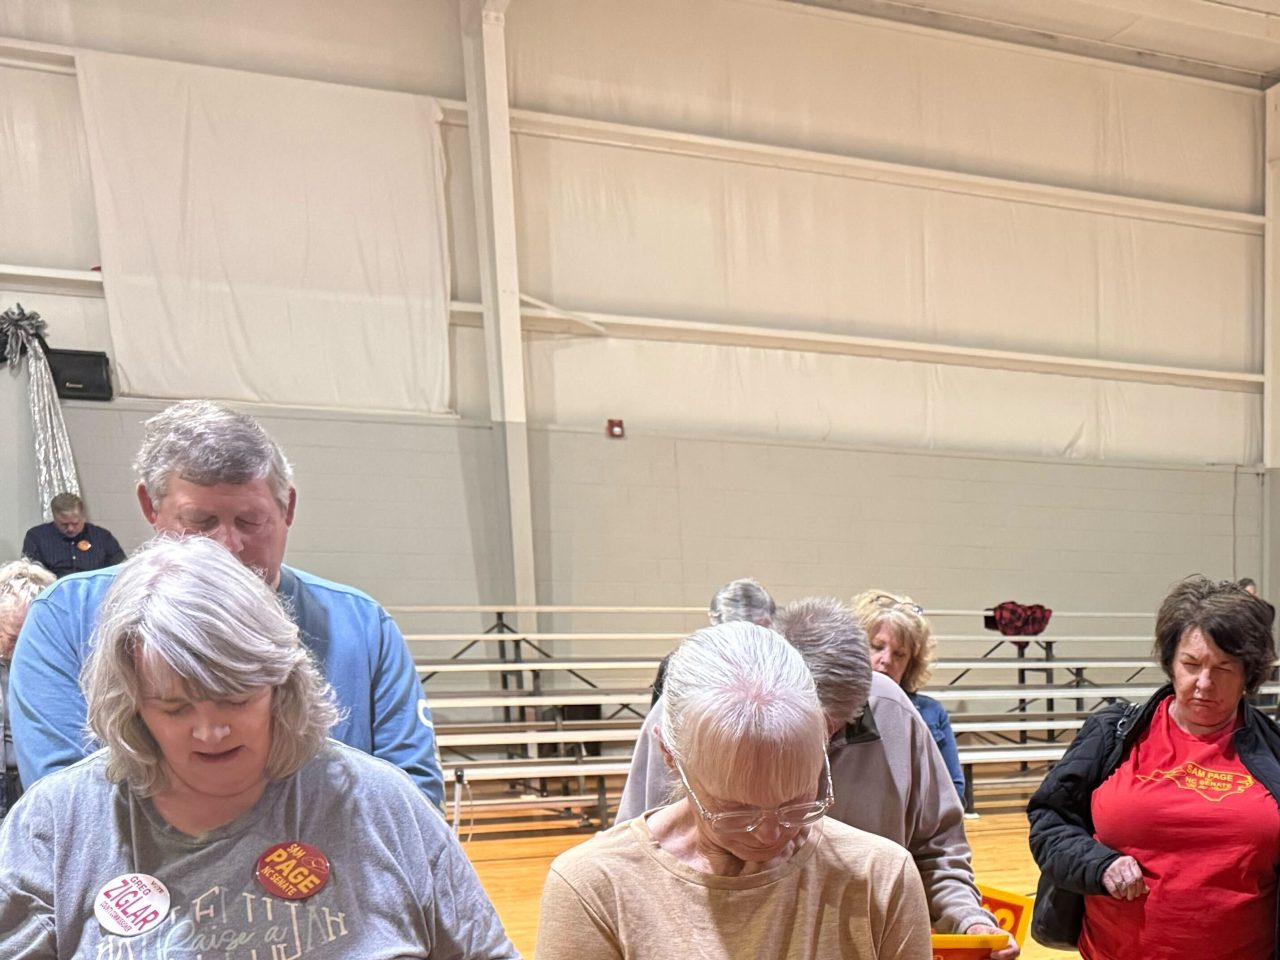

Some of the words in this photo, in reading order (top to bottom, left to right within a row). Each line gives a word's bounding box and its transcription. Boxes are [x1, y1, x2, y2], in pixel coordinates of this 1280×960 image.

[1186, 764, 1206, 778] SAM
[1208, 772, 1233, 782] PAGE
[286, 843, 306, 859] SAM
[261, 865, 275, 877] NC
[270, 873, 297, 896] SENATE
[264, 848, 321, 894] PAGE
[130, 876, 151, 896] GREG
[103, 879, 159, 931] ZIGLAR
[264, 924, 288, 944] a
